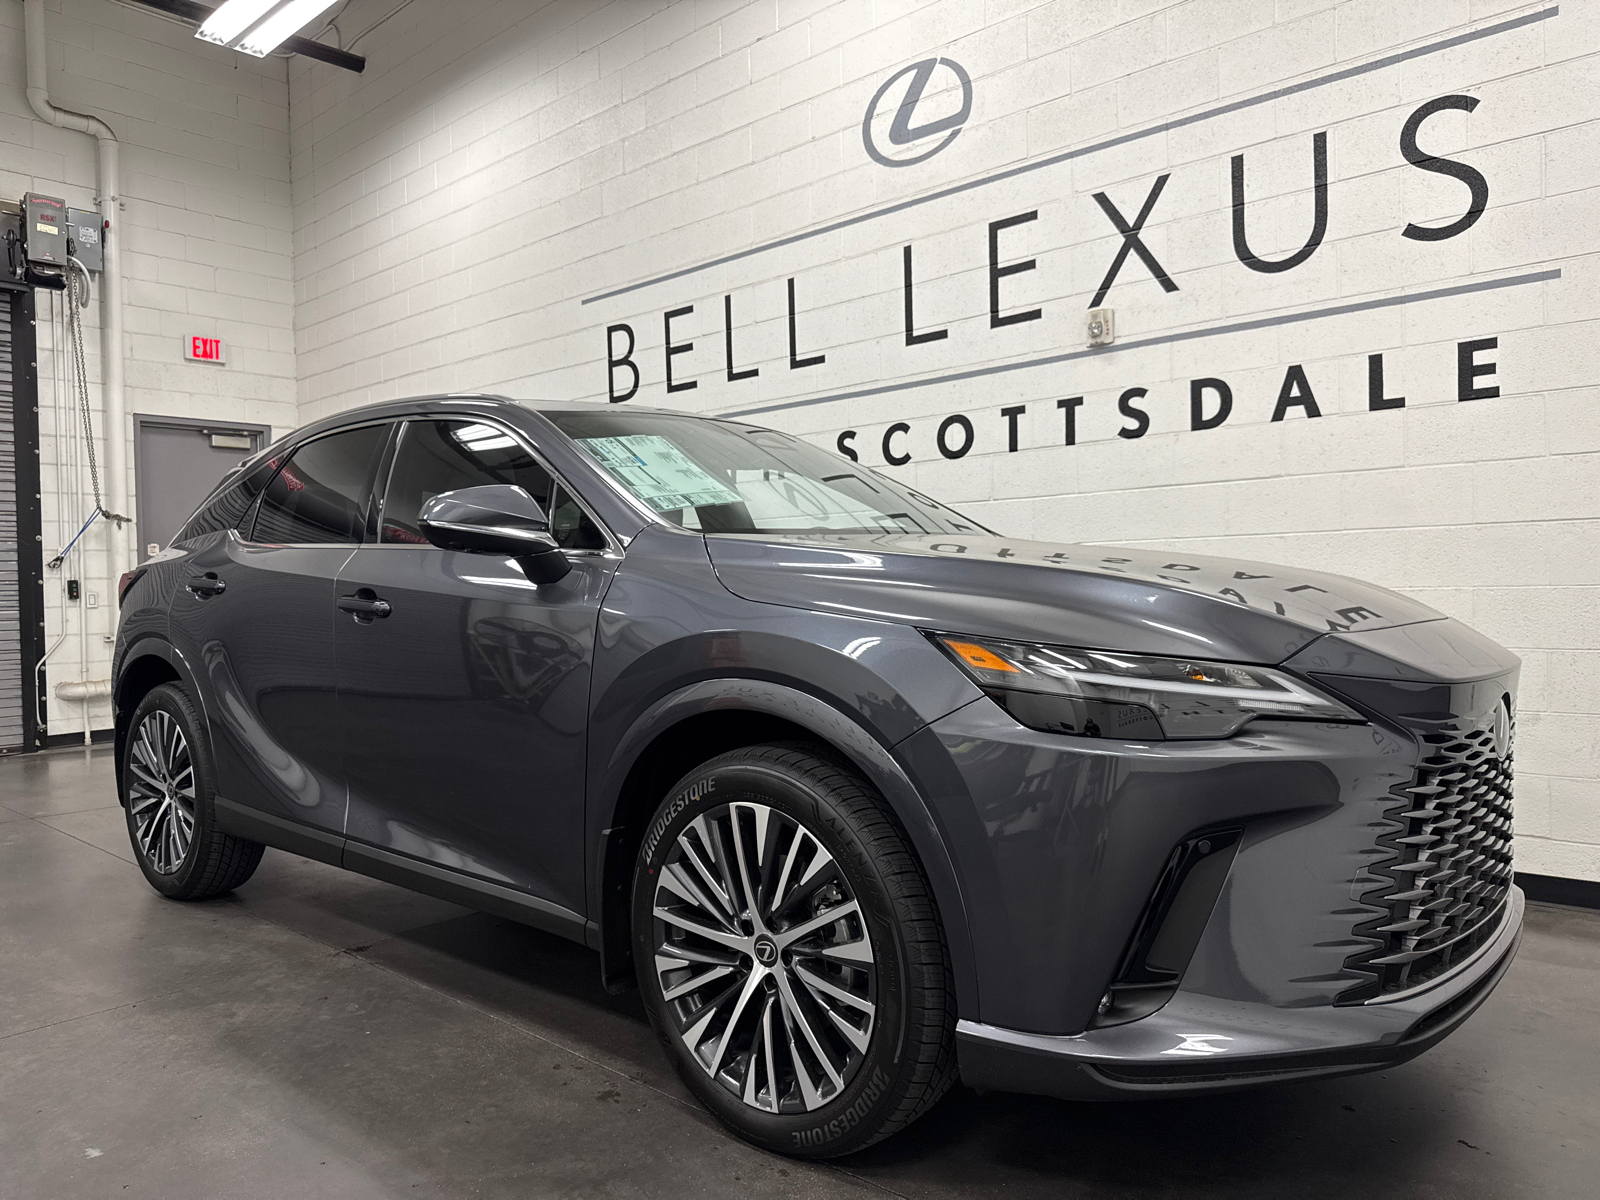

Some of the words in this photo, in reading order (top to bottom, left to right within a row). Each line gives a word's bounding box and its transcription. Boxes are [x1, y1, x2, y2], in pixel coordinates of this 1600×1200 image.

[606, 277, 826, 404] BELL
[903, 94, 1489, 347] LEXUS
[192, 336, 221, 361] EXIT
[836, 336, 1501, 467] SCOTTSDALE
[642, 776, 716, 866] BRIDGESTONE
[825, 816, 883, 904] ALENZA
[792, 1065, 890, 1148] BRIDGESTONE
